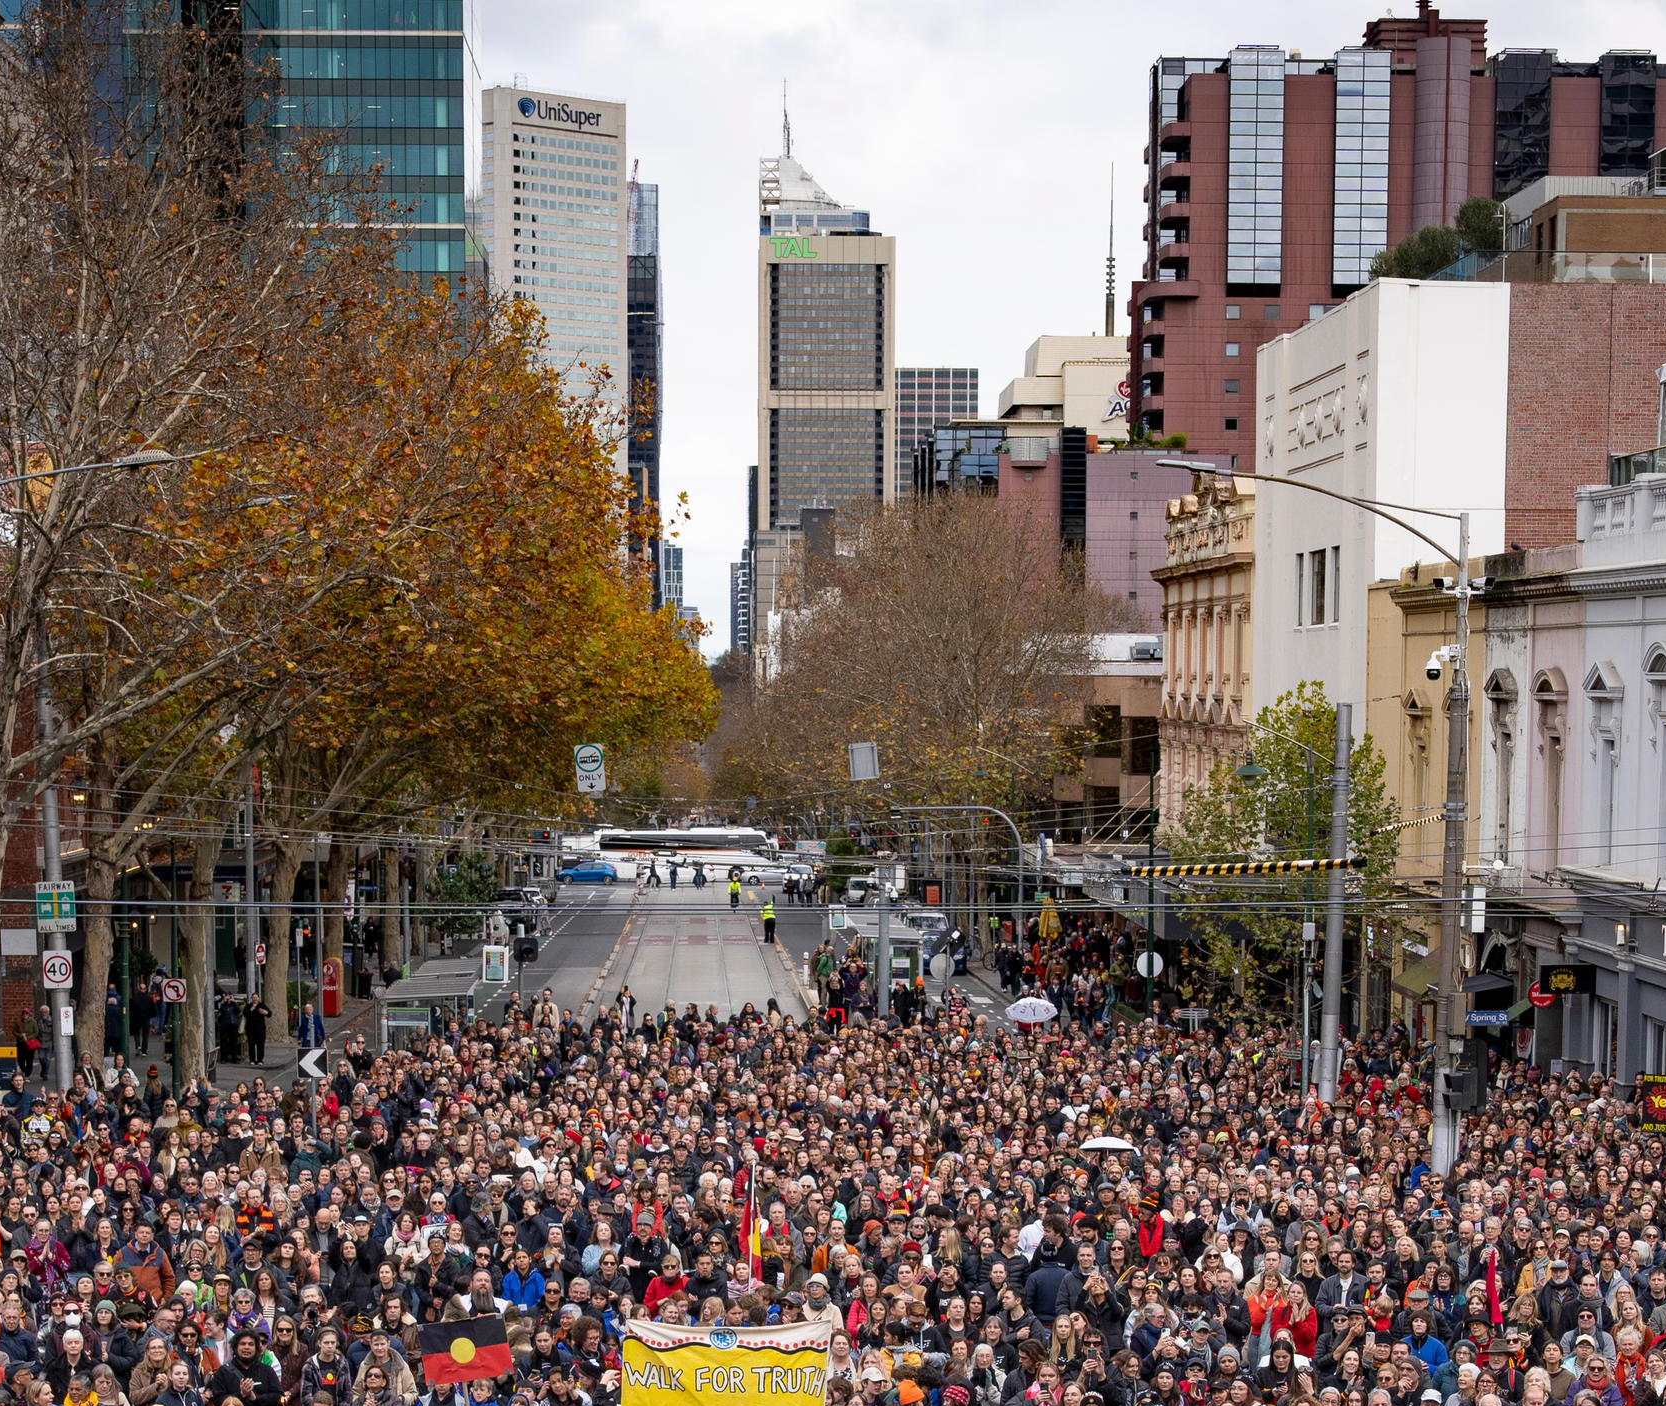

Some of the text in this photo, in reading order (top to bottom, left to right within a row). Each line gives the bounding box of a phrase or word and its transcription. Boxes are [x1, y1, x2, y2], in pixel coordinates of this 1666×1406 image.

[537, 99, 602, 129] UniSuper
[769, 238, 818, 258] TAL
[578, 773, 603, 782] ONLY
[38, 882, 72, 891] FAIRWAY
[56, 923, 76, 931] TIMES
[46, 962, 68, 976] 40
[1470, 1013, 1508, 1024] Spring St
[1642, 1123, 1654, 1131] AND
[624, 1362, 827, 1399] WALK FOR TRUTH
